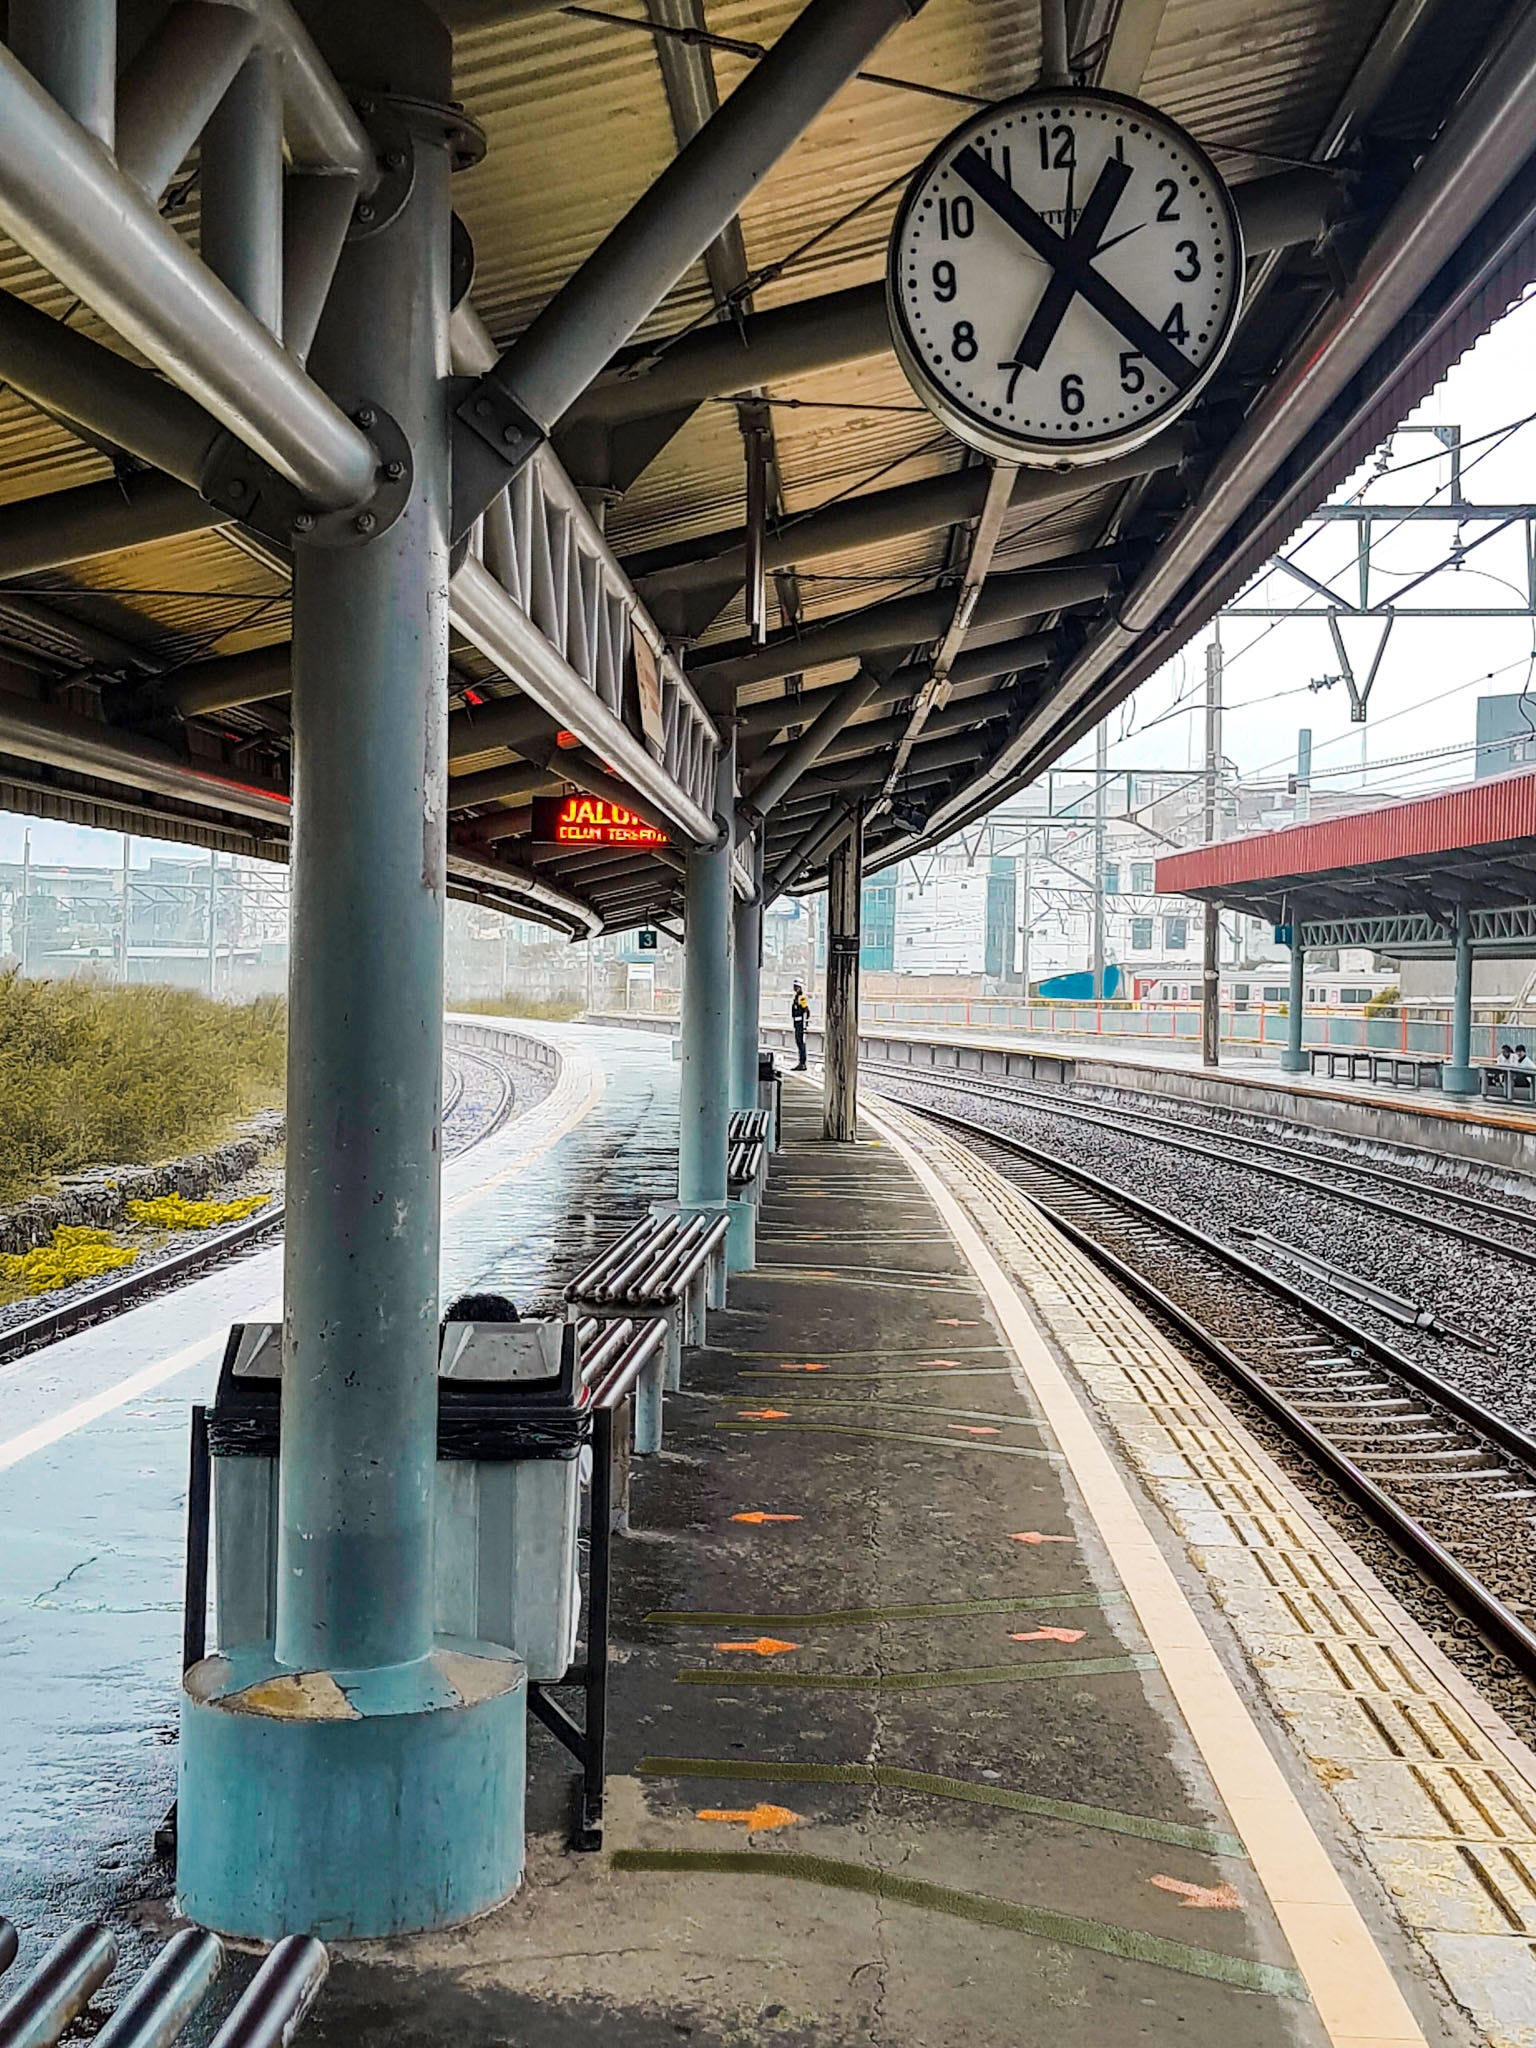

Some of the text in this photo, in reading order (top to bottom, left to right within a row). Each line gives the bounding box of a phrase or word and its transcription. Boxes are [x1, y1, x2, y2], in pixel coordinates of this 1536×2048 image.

[1038, 125, 1077, 170] 12
[938, 195, 975, 241] 10
[1154, 179, 1181, 222] 2
[932, 260, 957, 303] 9
[1173, 240, 1201, 283] 3
[951, 320, 978, 363] 8
[1160, 302, 1190, 346] 4
[997, 362, 1025, 405] 7
[1119, 352, 1145, 394] 5
[1060, 374, 1085, 416] 6
[643, 934, 653, 947] 3
